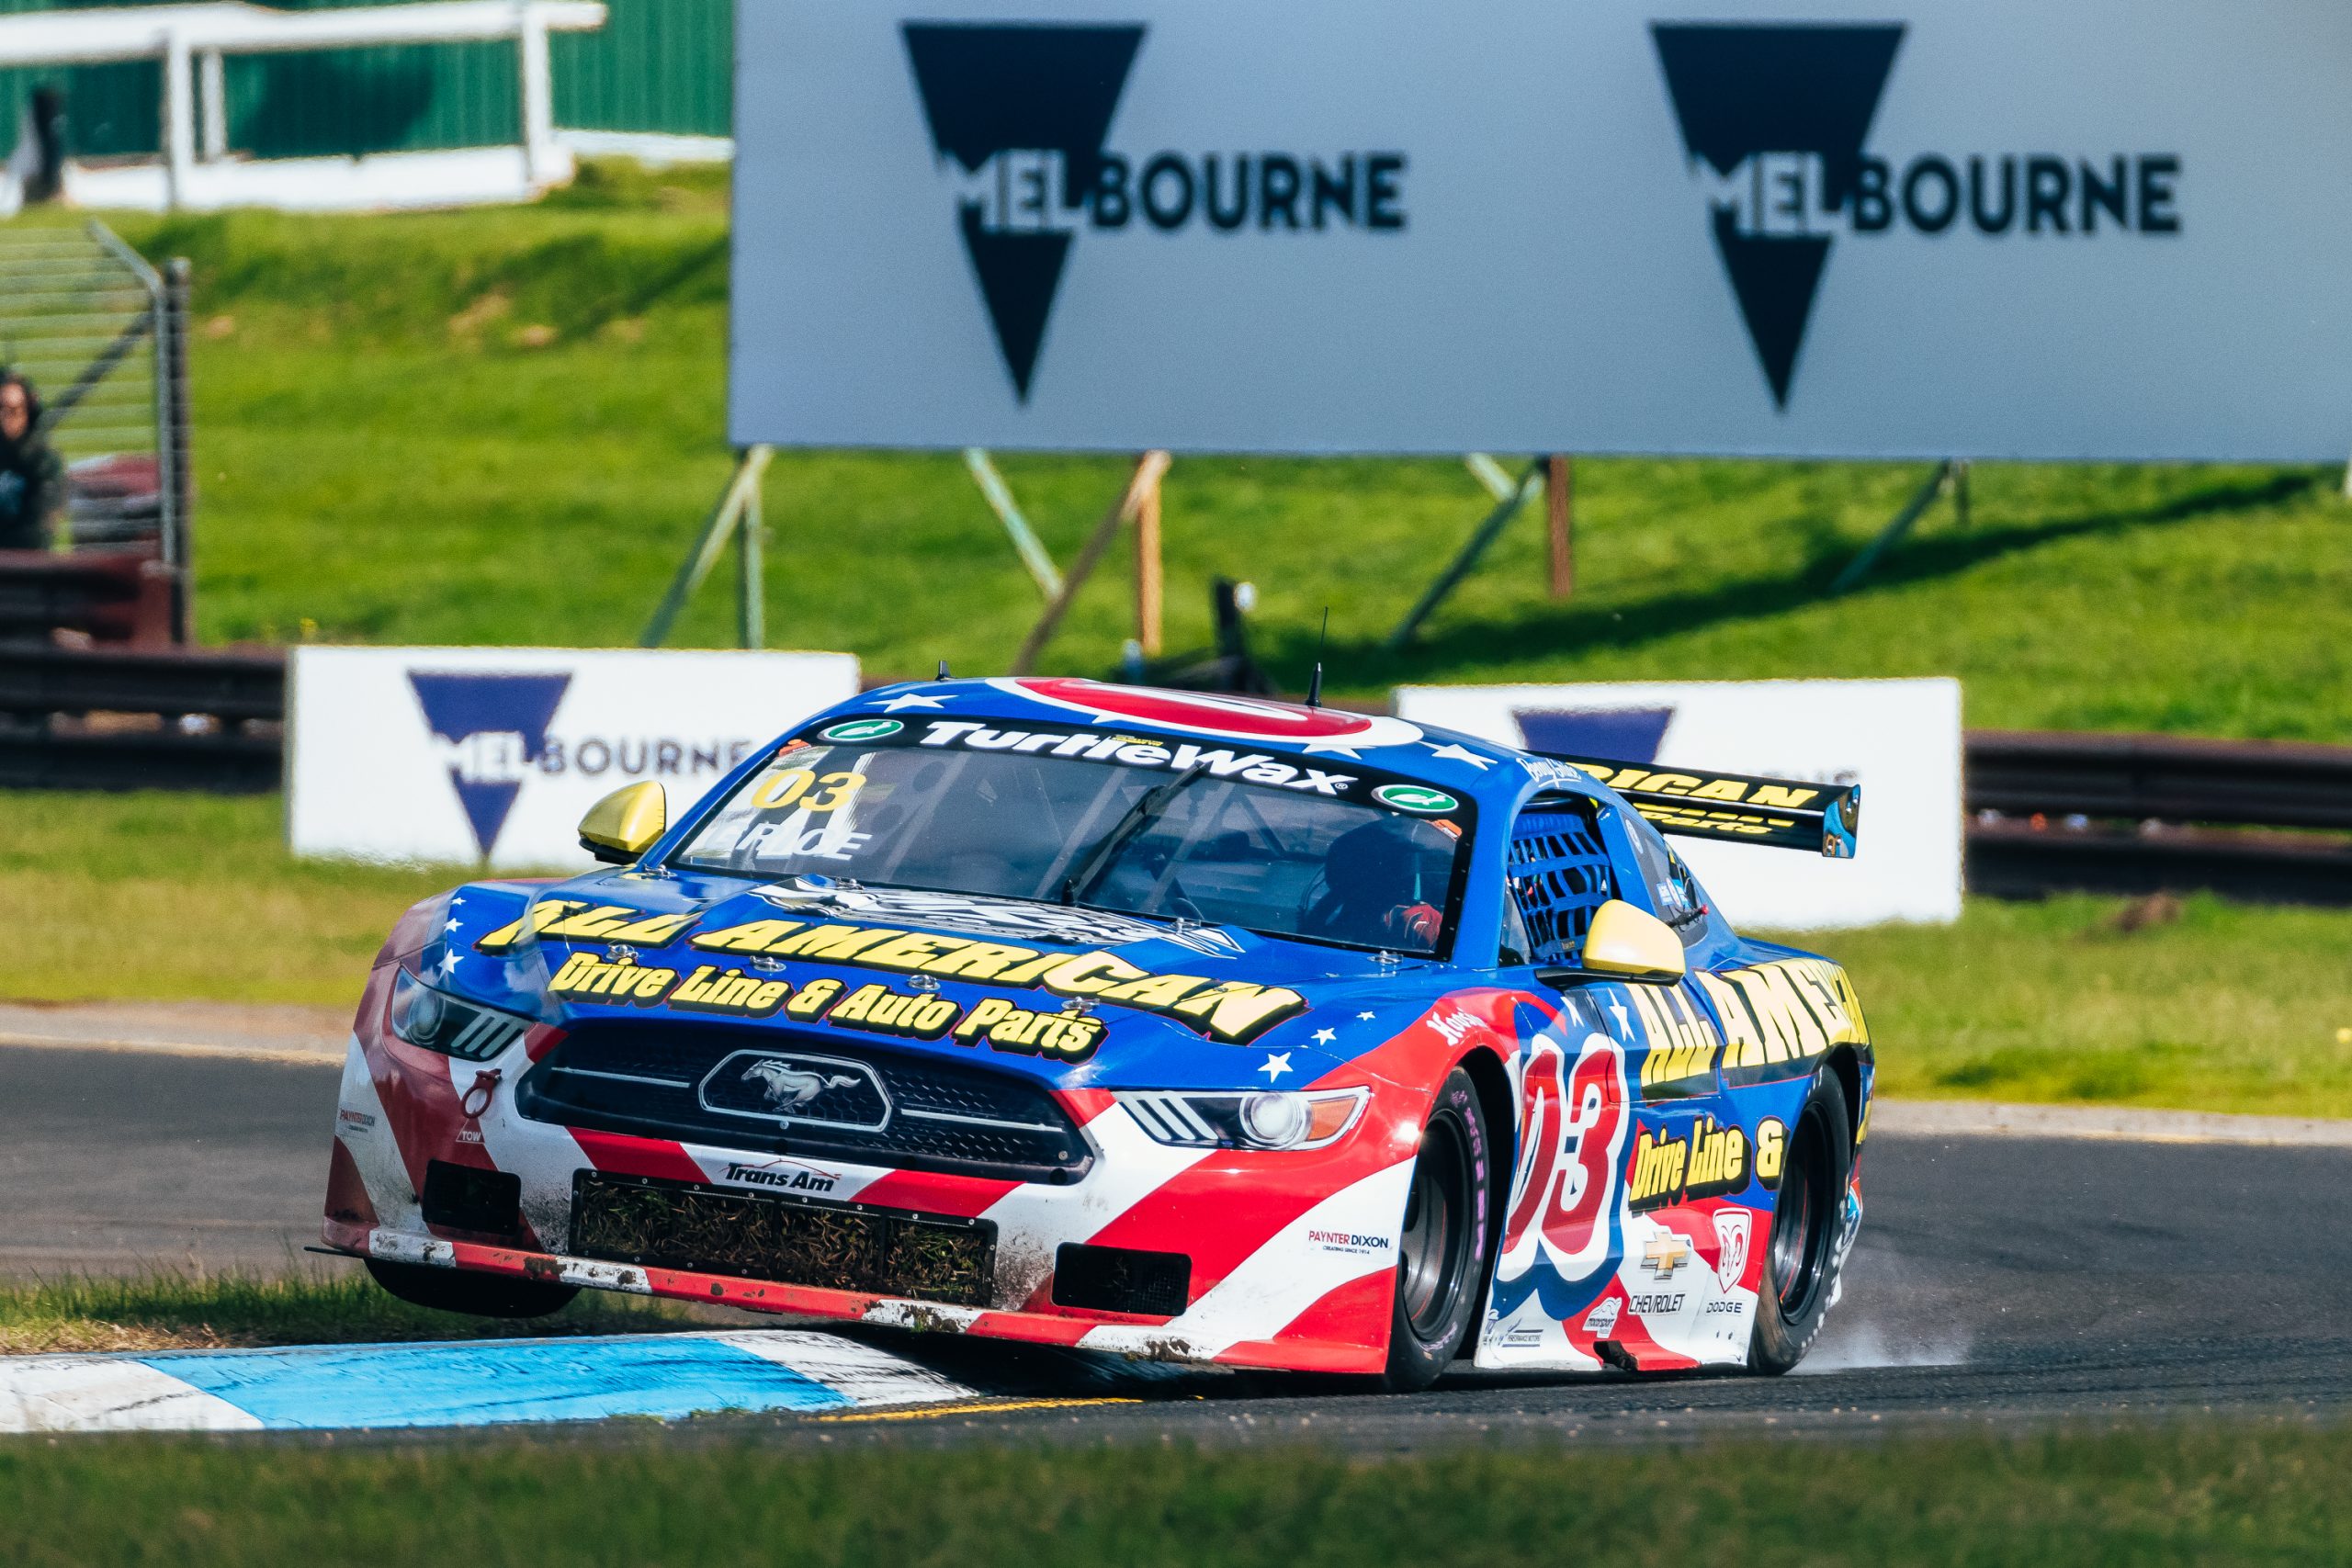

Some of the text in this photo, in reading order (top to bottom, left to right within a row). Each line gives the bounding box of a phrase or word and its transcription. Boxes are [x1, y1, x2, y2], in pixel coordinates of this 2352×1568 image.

[937, 149, 1410, 233] MELBOURNE
[1690, 152, 2183, 235] MELBOURNE
[751, 769, 867, 811] 03
[479, 899, 1303, 1036] ALL AMERICAN
[548, 953, 1102, 1051] Drive Line & Auto Parts
[1624, 983, 1713, 1088] ALL
[462, 1131, 481, 1142] TOW
[726, 1162, 834, 1191] Trans Am
[1497, 1032, 1629, 1282] 03
[1629, 1117, 1784, 1201] Drive Line &
[1308, 1230, 1389, 1248] PAYNTER DIXON
[1628, 1293, 1686, 1314] CHEVROLET
[1706, 1302, 1743, 1314] DODGE
